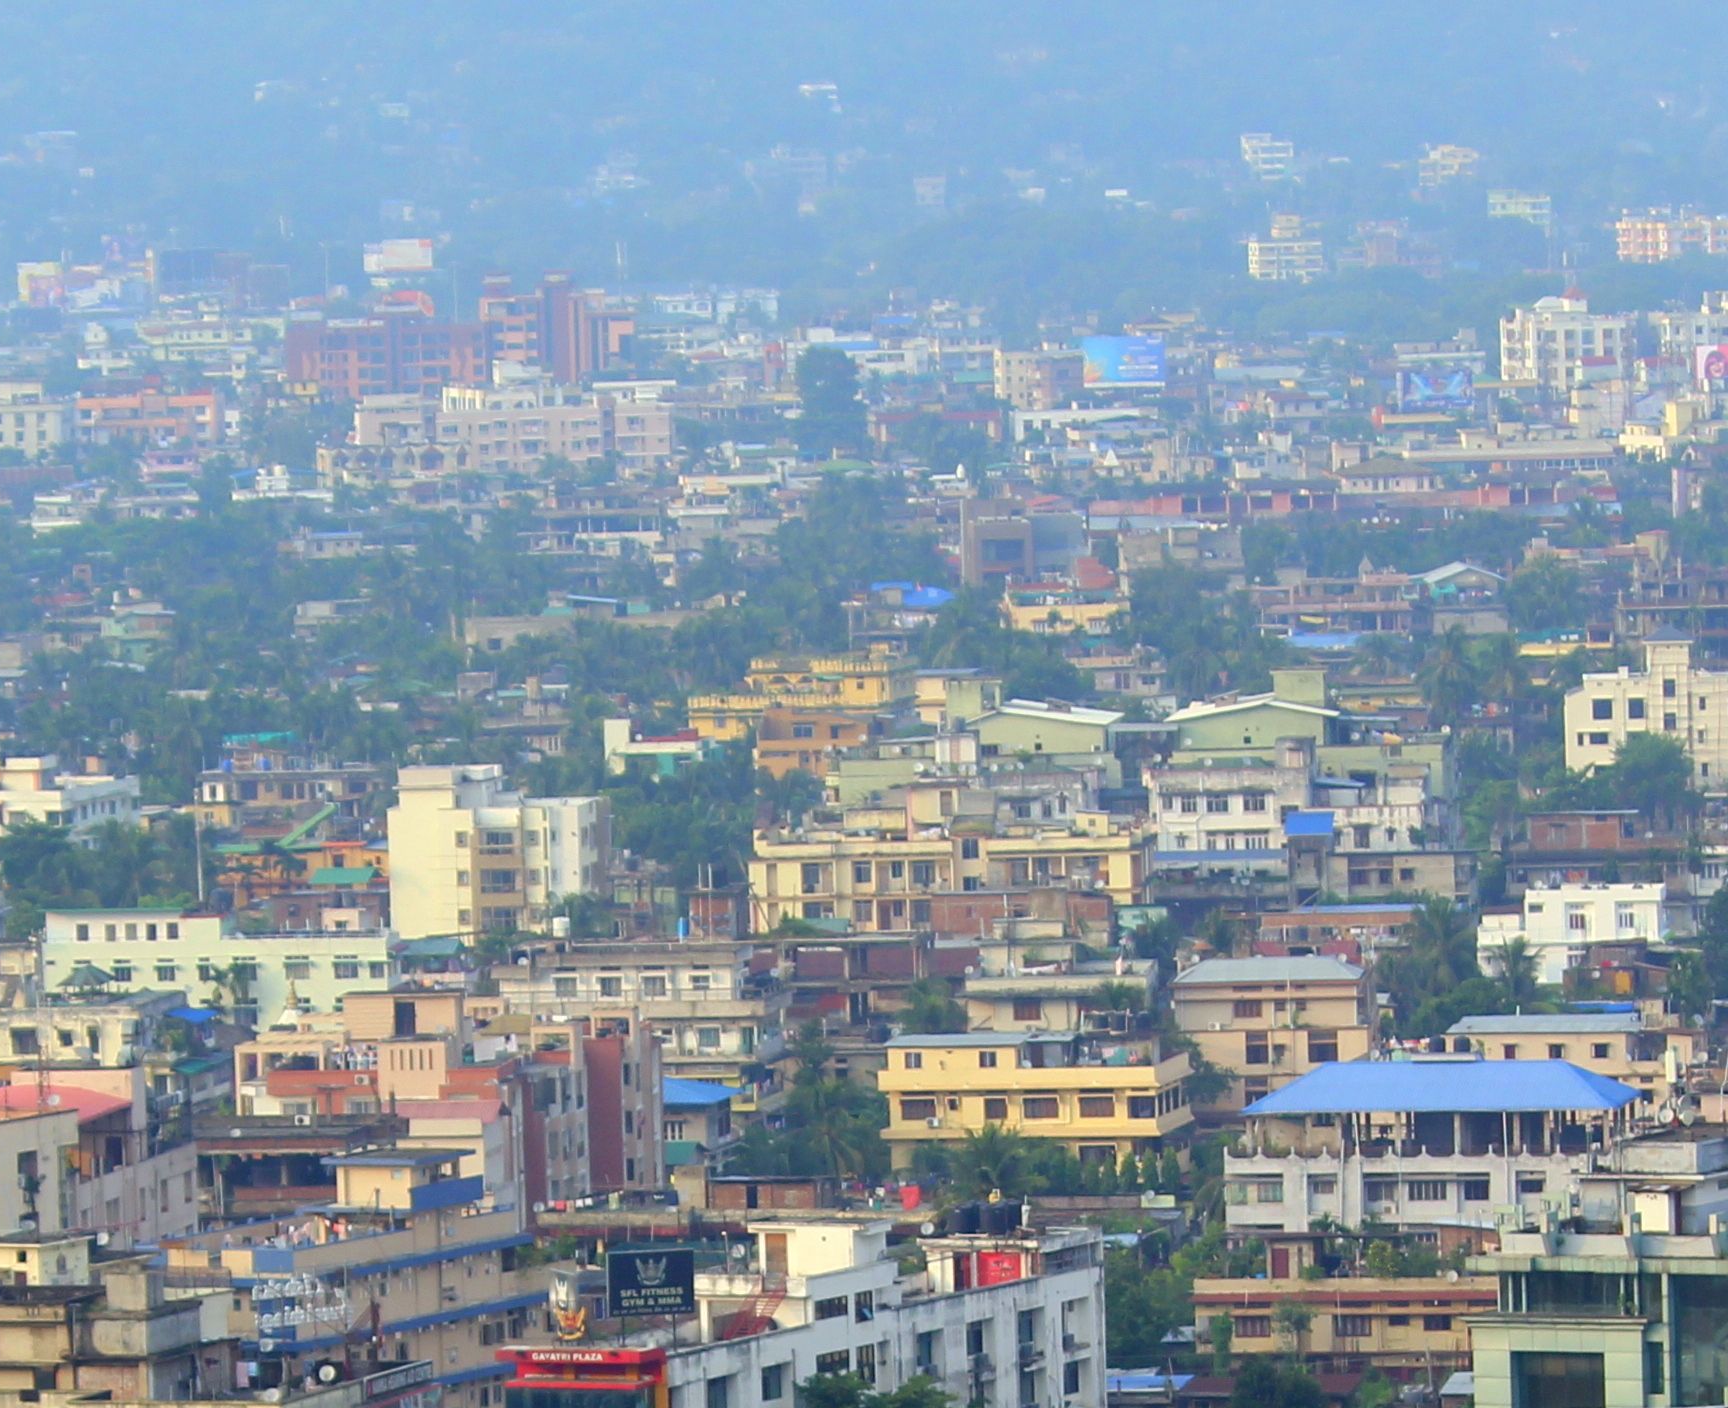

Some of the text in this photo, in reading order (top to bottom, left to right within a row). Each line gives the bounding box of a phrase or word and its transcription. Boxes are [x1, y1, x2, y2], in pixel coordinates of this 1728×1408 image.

[620, 1287, 684, 1298] SFL FITNESS
[622, 1298, 644, 1307] GYM
[658, 1296, 682, 1306] MMA
[532, 1352, 604, 1361] GAYATRI PLAZA
